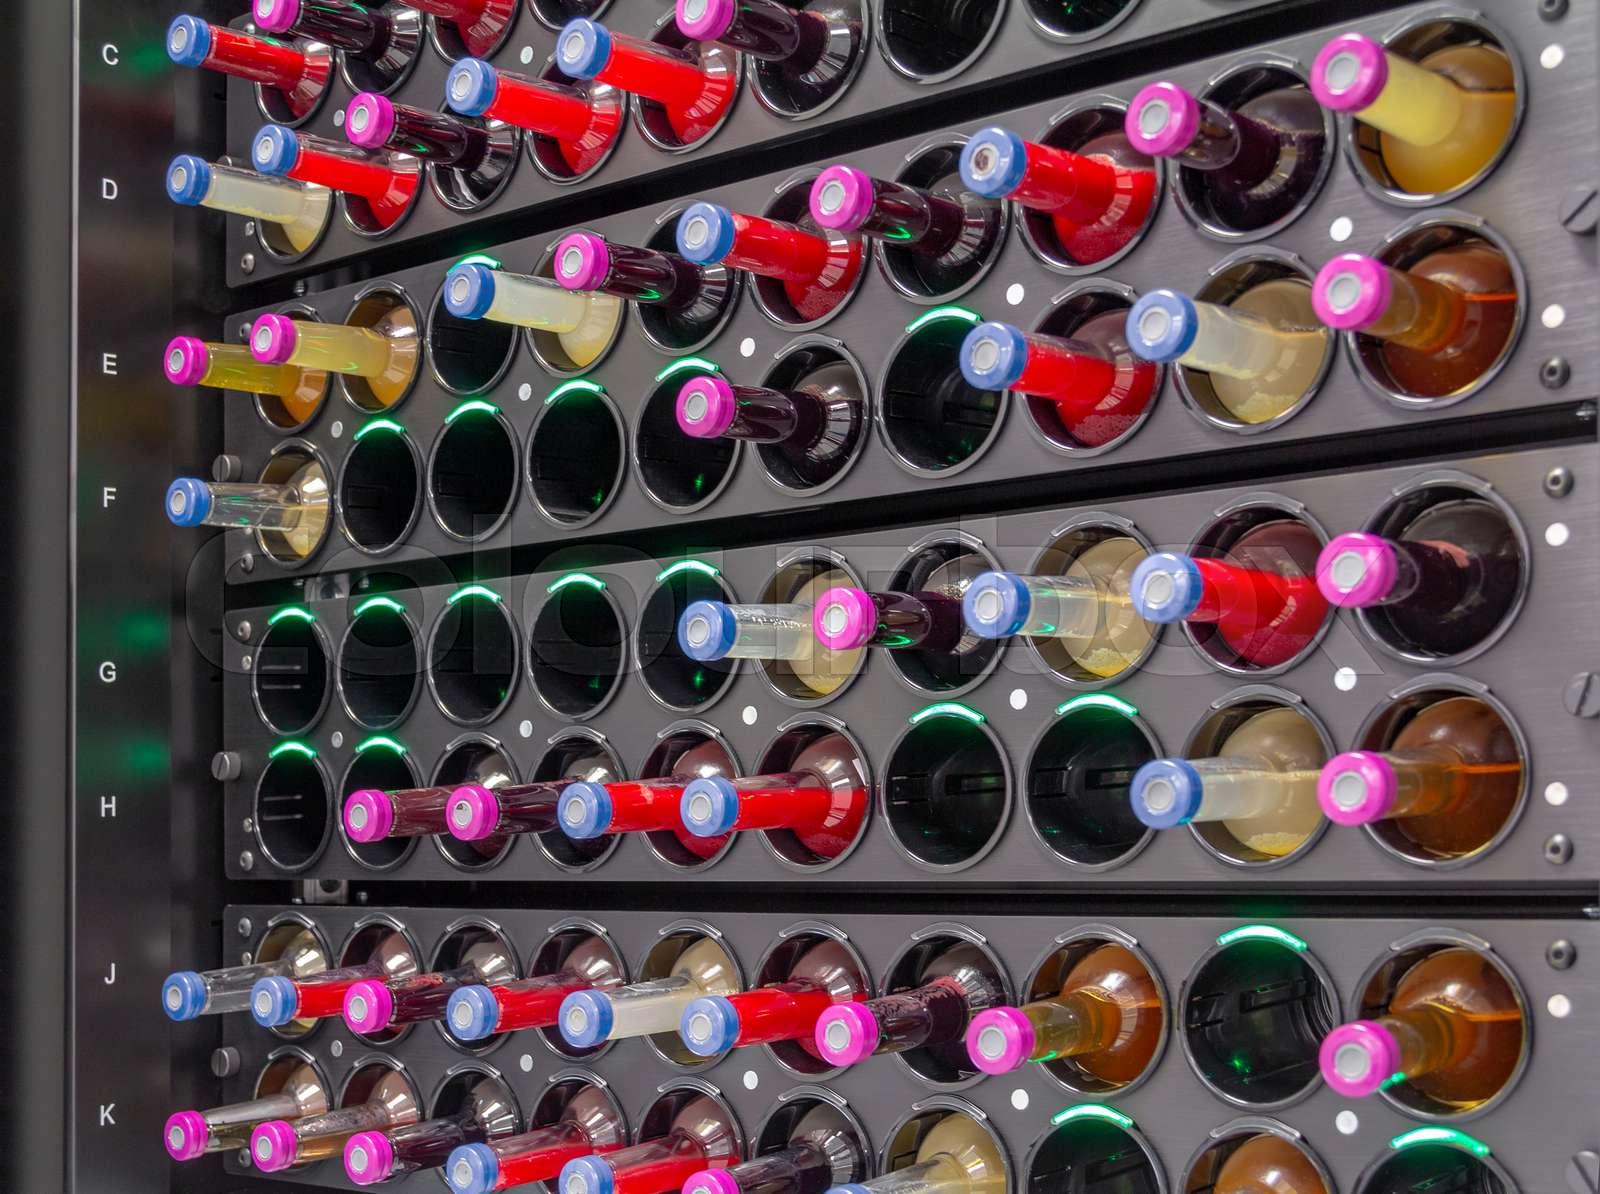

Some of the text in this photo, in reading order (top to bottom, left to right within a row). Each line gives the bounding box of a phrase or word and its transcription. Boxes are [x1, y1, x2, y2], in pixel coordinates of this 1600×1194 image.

[101, 43, 119, 66] C
[101, 177, 118, 200] D
[102, 352, 118, 375] E
[102, 486, 117, 508] F
[99, 661, 116, 683] G
[100, 795, 116, 818] H
[103, 962, 116, 985] J
[99, 1103, 116, 1126] K
